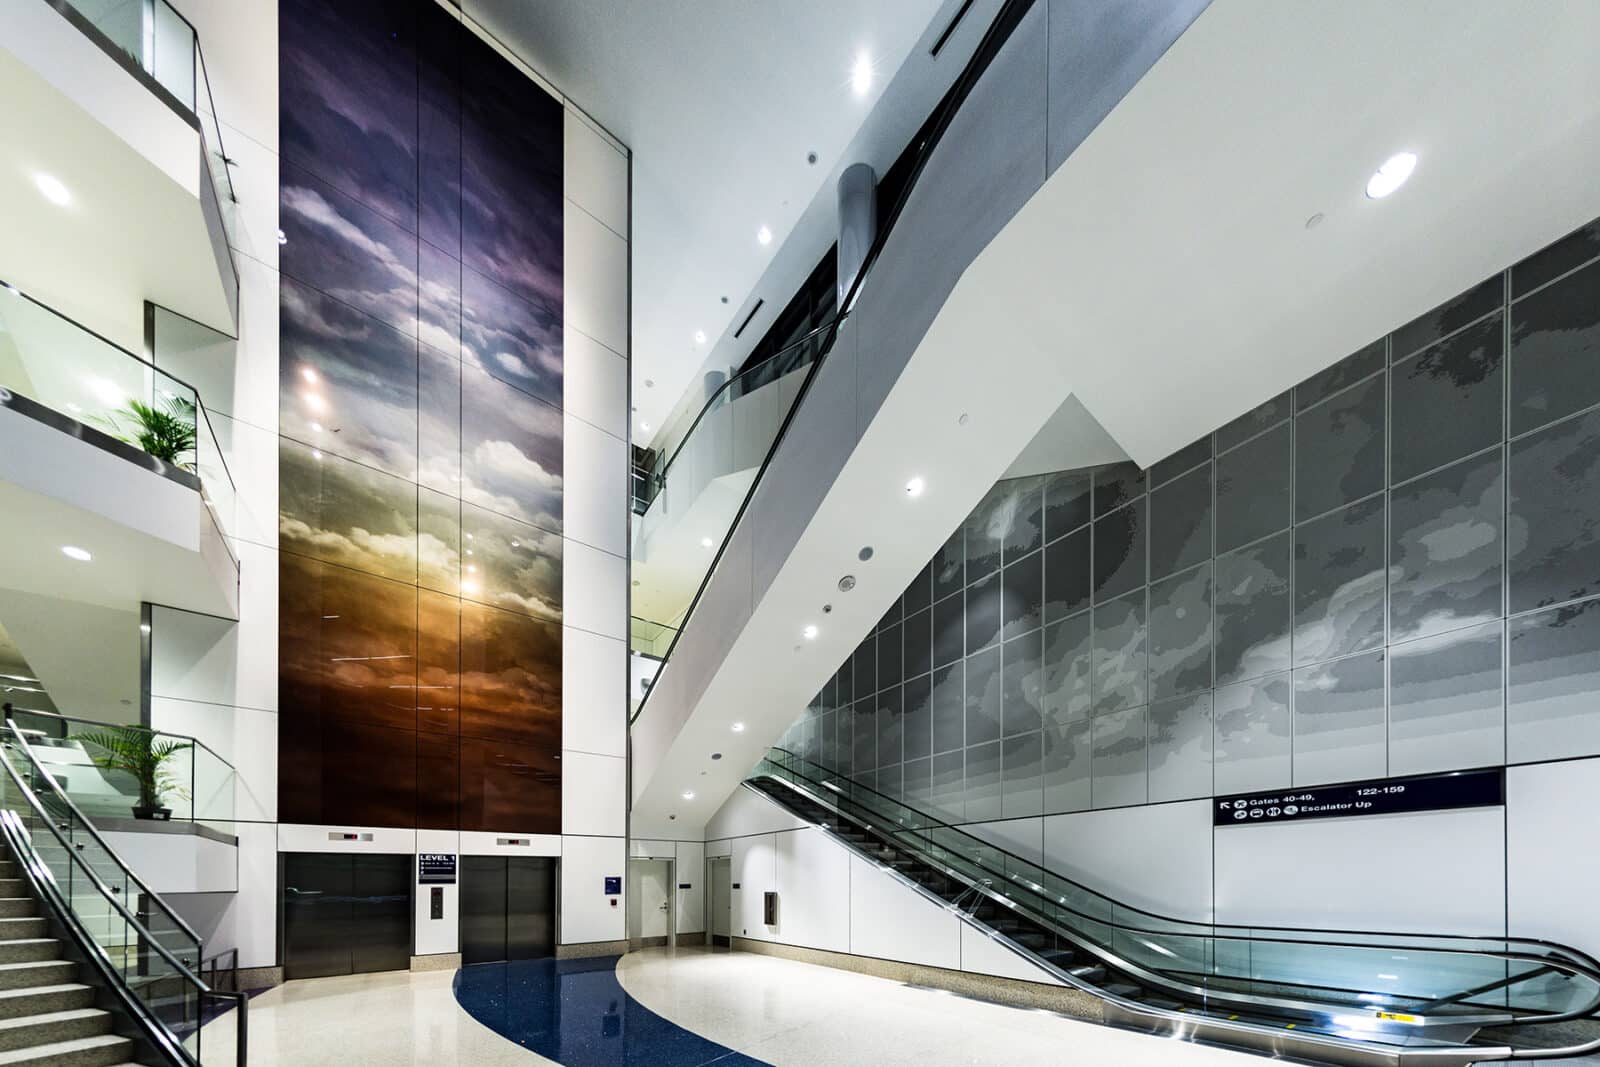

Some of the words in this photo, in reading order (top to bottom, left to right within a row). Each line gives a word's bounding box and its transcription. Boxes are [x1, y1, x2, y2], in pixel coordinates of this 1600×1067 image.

[1250, 797, 1279, 806] Gates
[1357, 786, 1405, 796] 122-159
[1301, 802, 1352, 812] Escalator
[1355, 800, 1372, 809] Up
